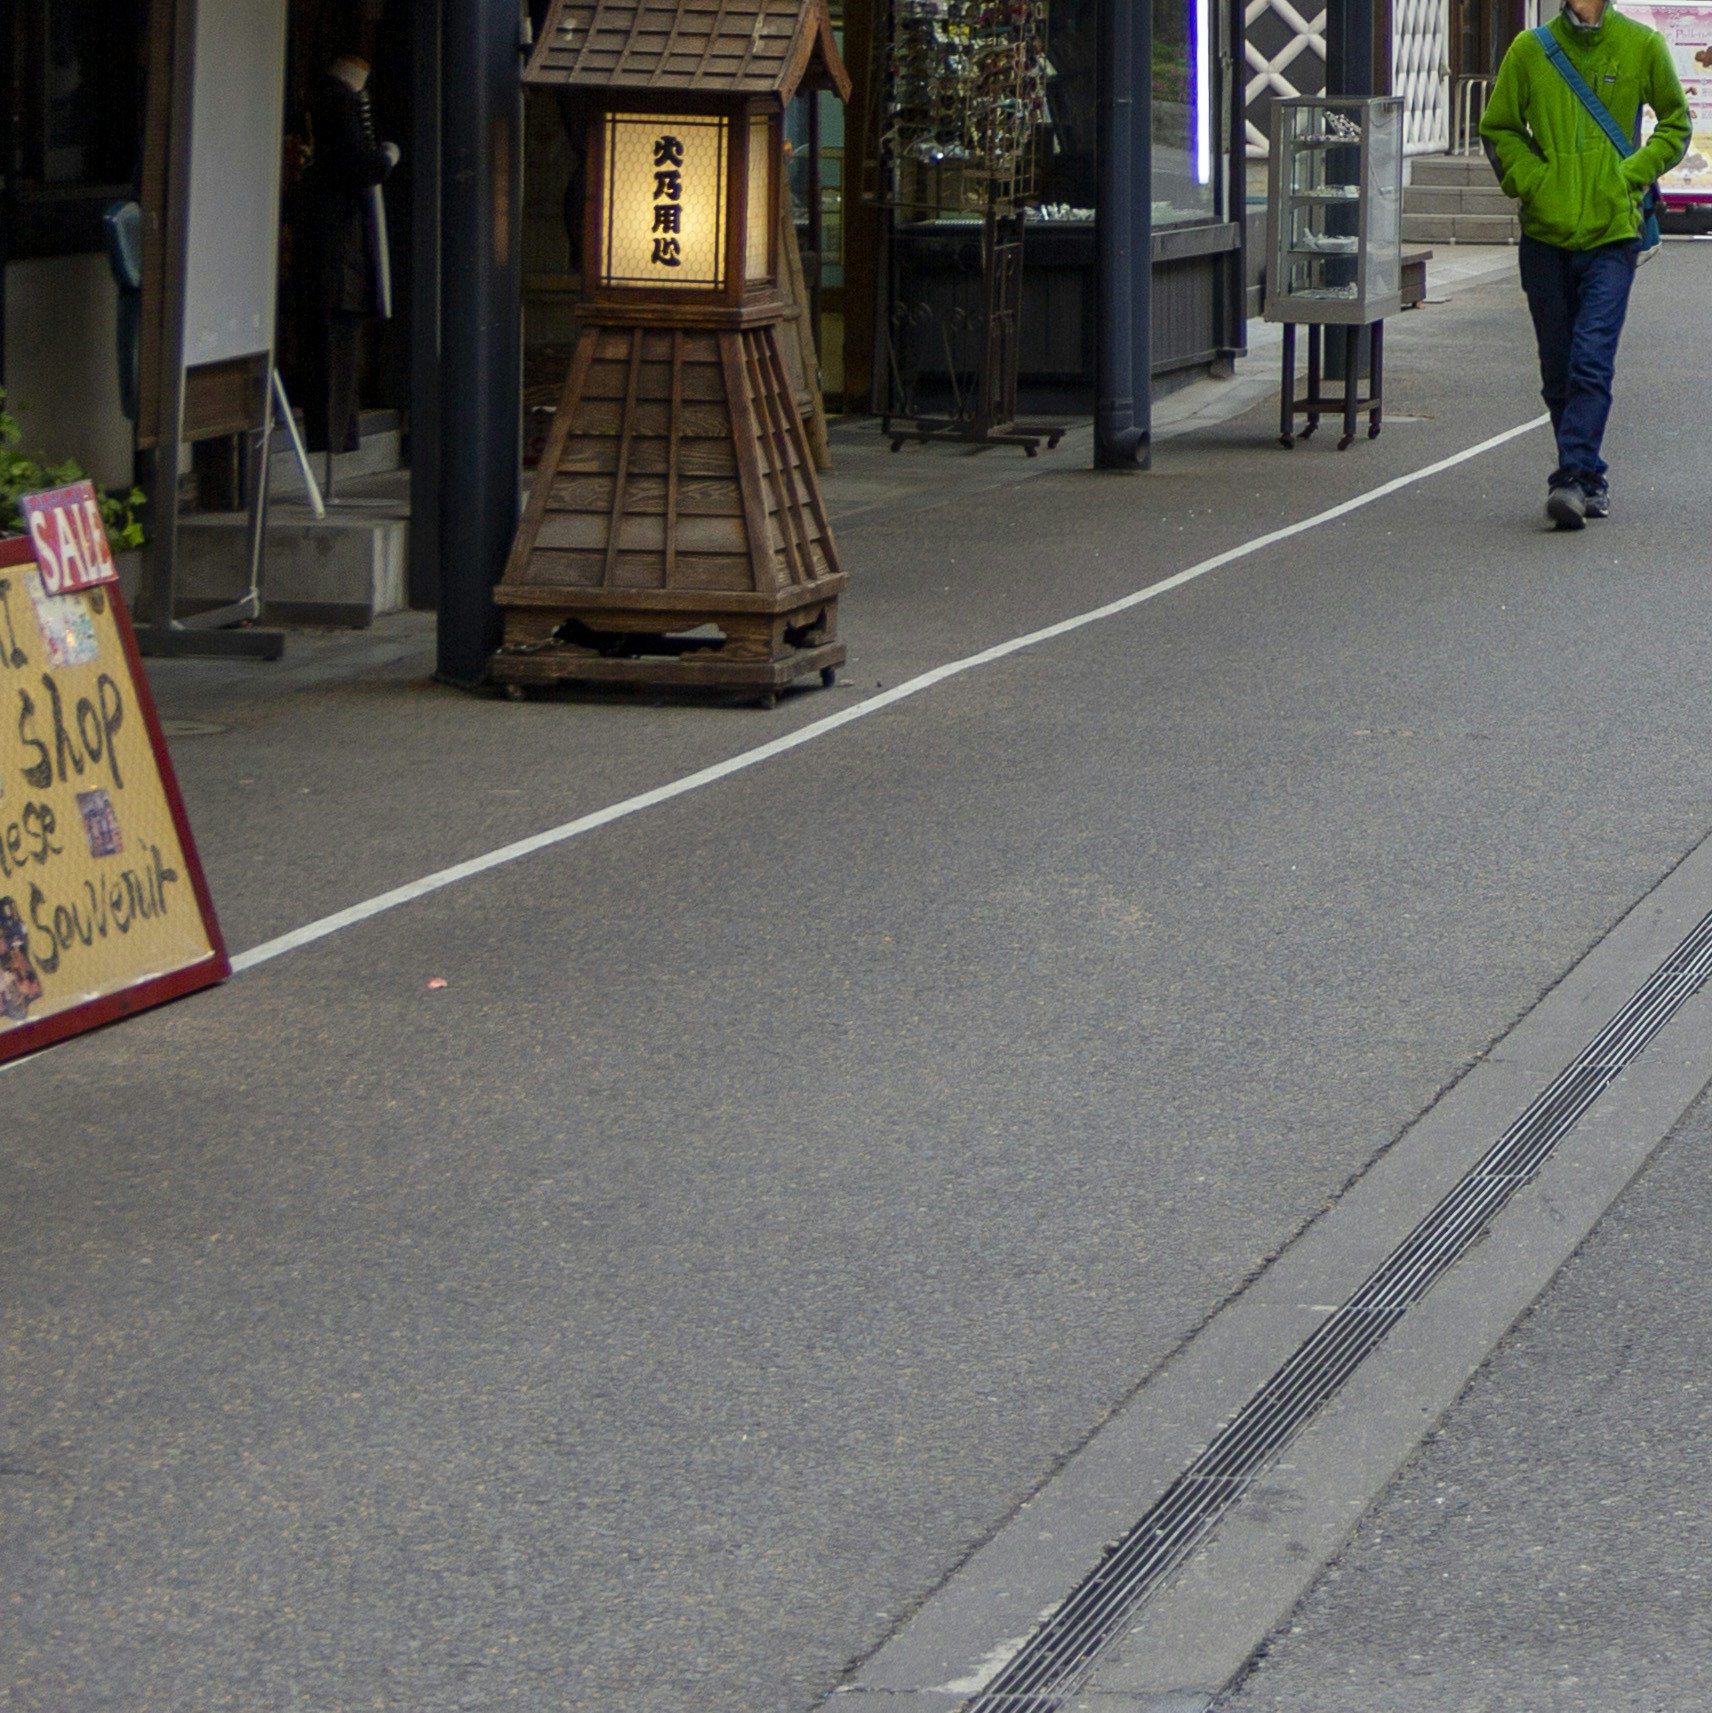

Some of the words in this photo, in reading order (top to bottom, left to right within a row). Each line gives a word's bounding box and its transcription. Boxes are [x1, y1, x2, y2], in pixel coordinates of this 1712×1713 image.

[651, 135, 684, 267] 火乃用心
[30, 499, 113, 592] SALE
